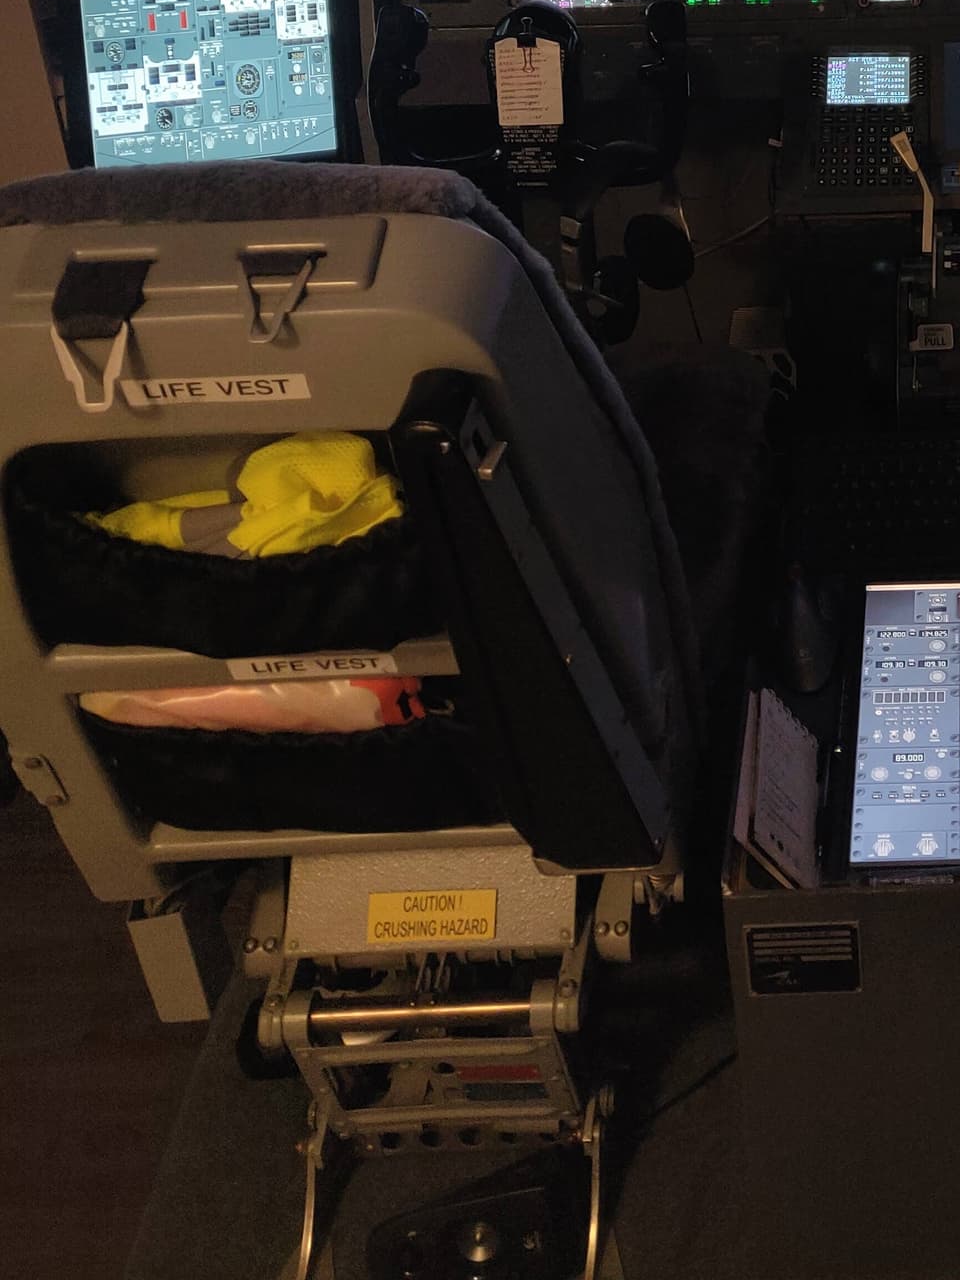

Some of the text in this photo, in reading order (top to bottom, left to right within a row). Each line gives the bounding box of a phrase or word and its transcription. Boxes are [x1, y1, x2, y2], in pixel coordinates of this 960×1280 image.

[924, 336, 946, 346] PULL
[143, 379, 289, 399] LIFE VEST
[251, 657, 381, 673] LIFE VEST
[895, 754, 923, 762] 89.000
[403, 895, 456, 912] CAUTION
[374, 918, 488, 938] CRUSHING HAZARD
